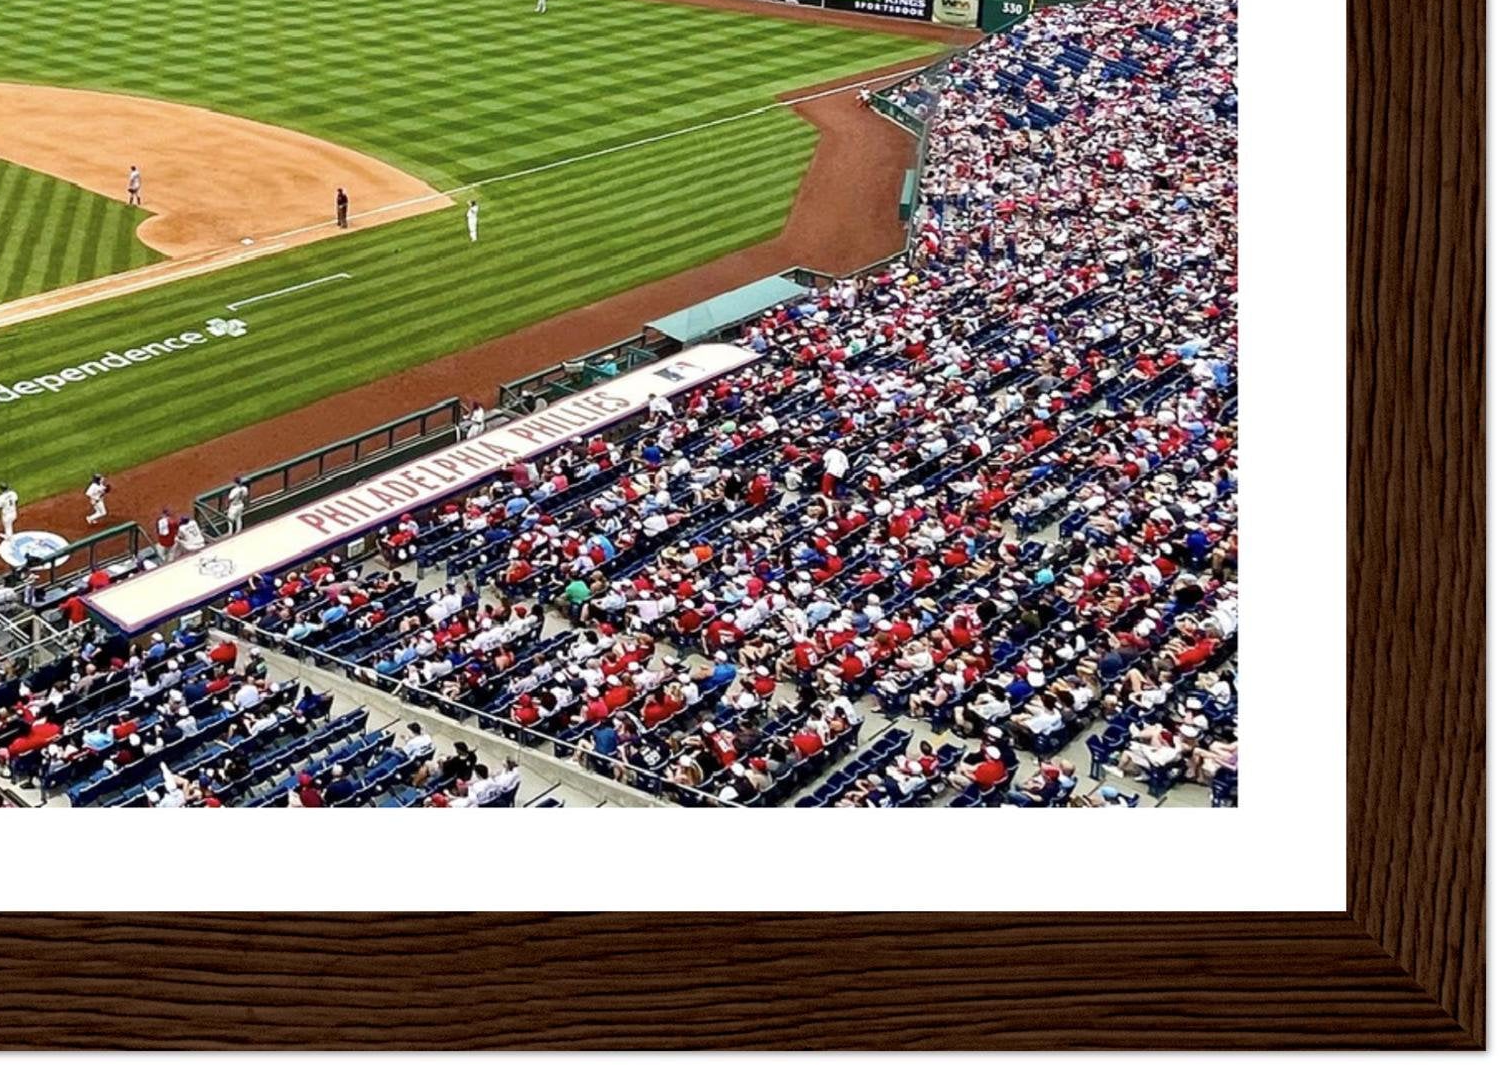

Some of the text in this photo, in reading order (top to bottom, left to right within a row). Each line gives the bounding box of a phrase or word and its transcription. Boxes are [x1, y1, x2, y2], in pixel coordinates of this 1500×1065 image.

[854, 1, 925, 17] SPORTSBOOK
[1002, 1, 1023, 15] 330
[296, 390, 631, 535] PHILADELPHIA PHILLIES
